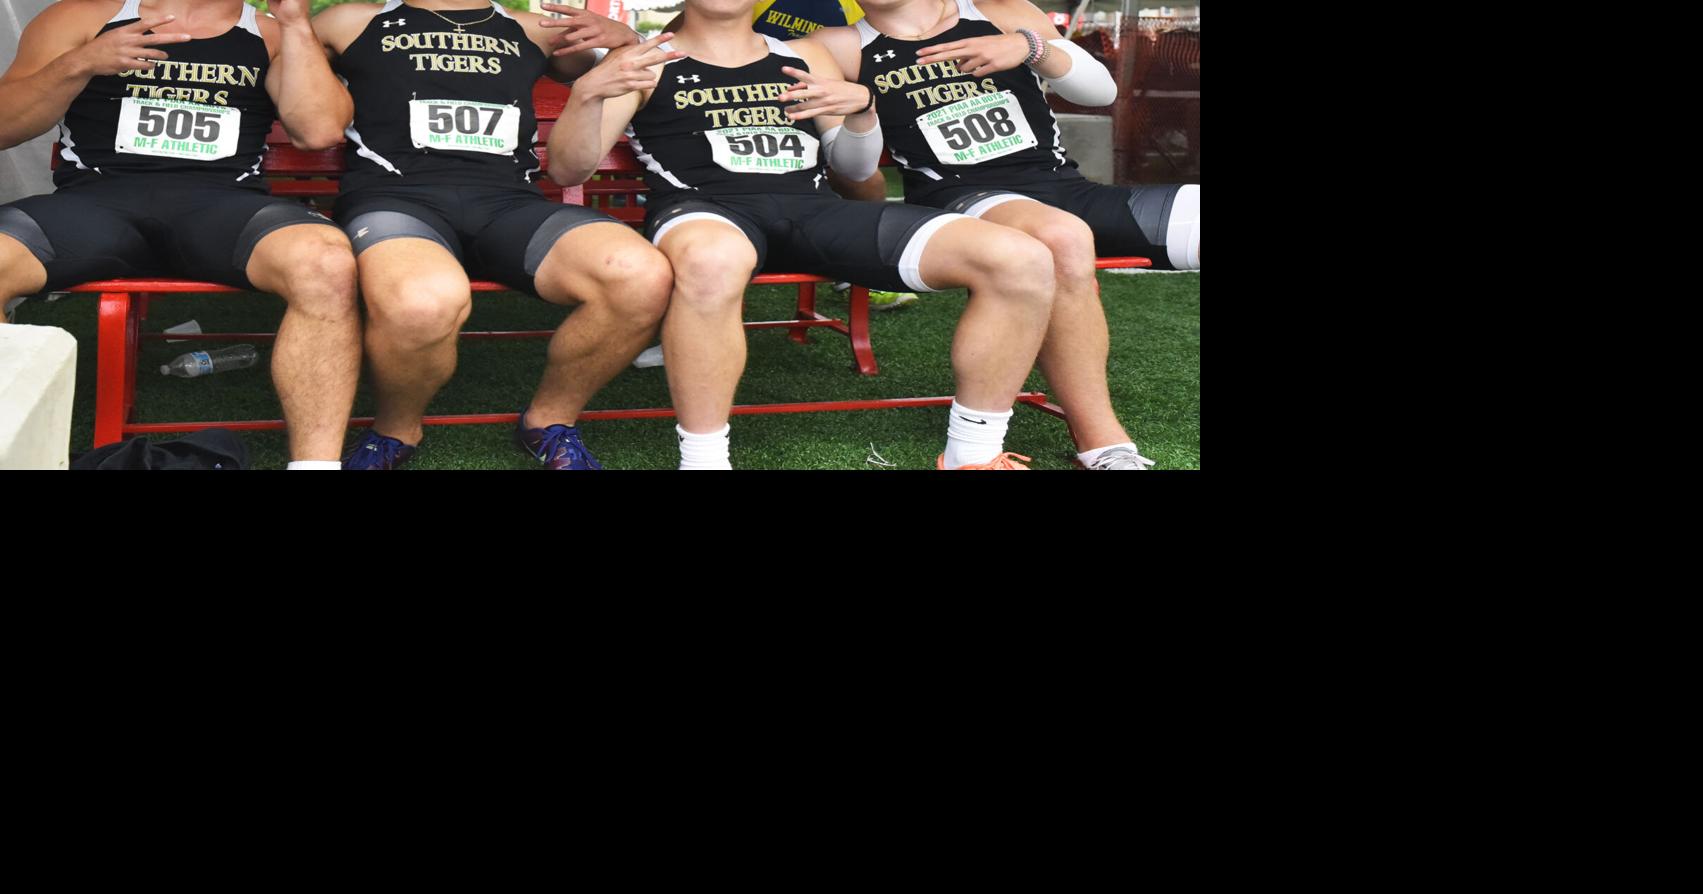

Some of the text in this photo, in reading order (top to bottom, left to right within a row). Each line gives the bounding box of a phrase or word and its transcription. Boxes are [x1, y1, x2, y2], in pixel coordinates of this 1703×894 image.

[381, 32, 520, 57] SOUTHERN
[409, 54, 502, 74] TIGERS
[874, 59, 972, 94] SOUTH
[126, 84, 229, 105] TIGERS
[906, 78, 997, 109] TIGERS
[927, 93, 1004, 120] 2021 PIAA AA BOYS
[138, 106, 221, 142] 505
[428, 105, 504, 136] 507
[937, 107, 1016, 150] 508
[134, 137, 158, 148] M-F
[161, 140, 218, 155] ATHLETIC
[429, 135, 451, 143] M-F
[456, 135, 504, 148] ATHLETIC
[725, 134, 805, 157] 504
[954, 148, 975, 162] M-F
[978, 135, 1023, 155] ATHLETIC
[730, 156, 804, 169] M-F ATHLETIC
